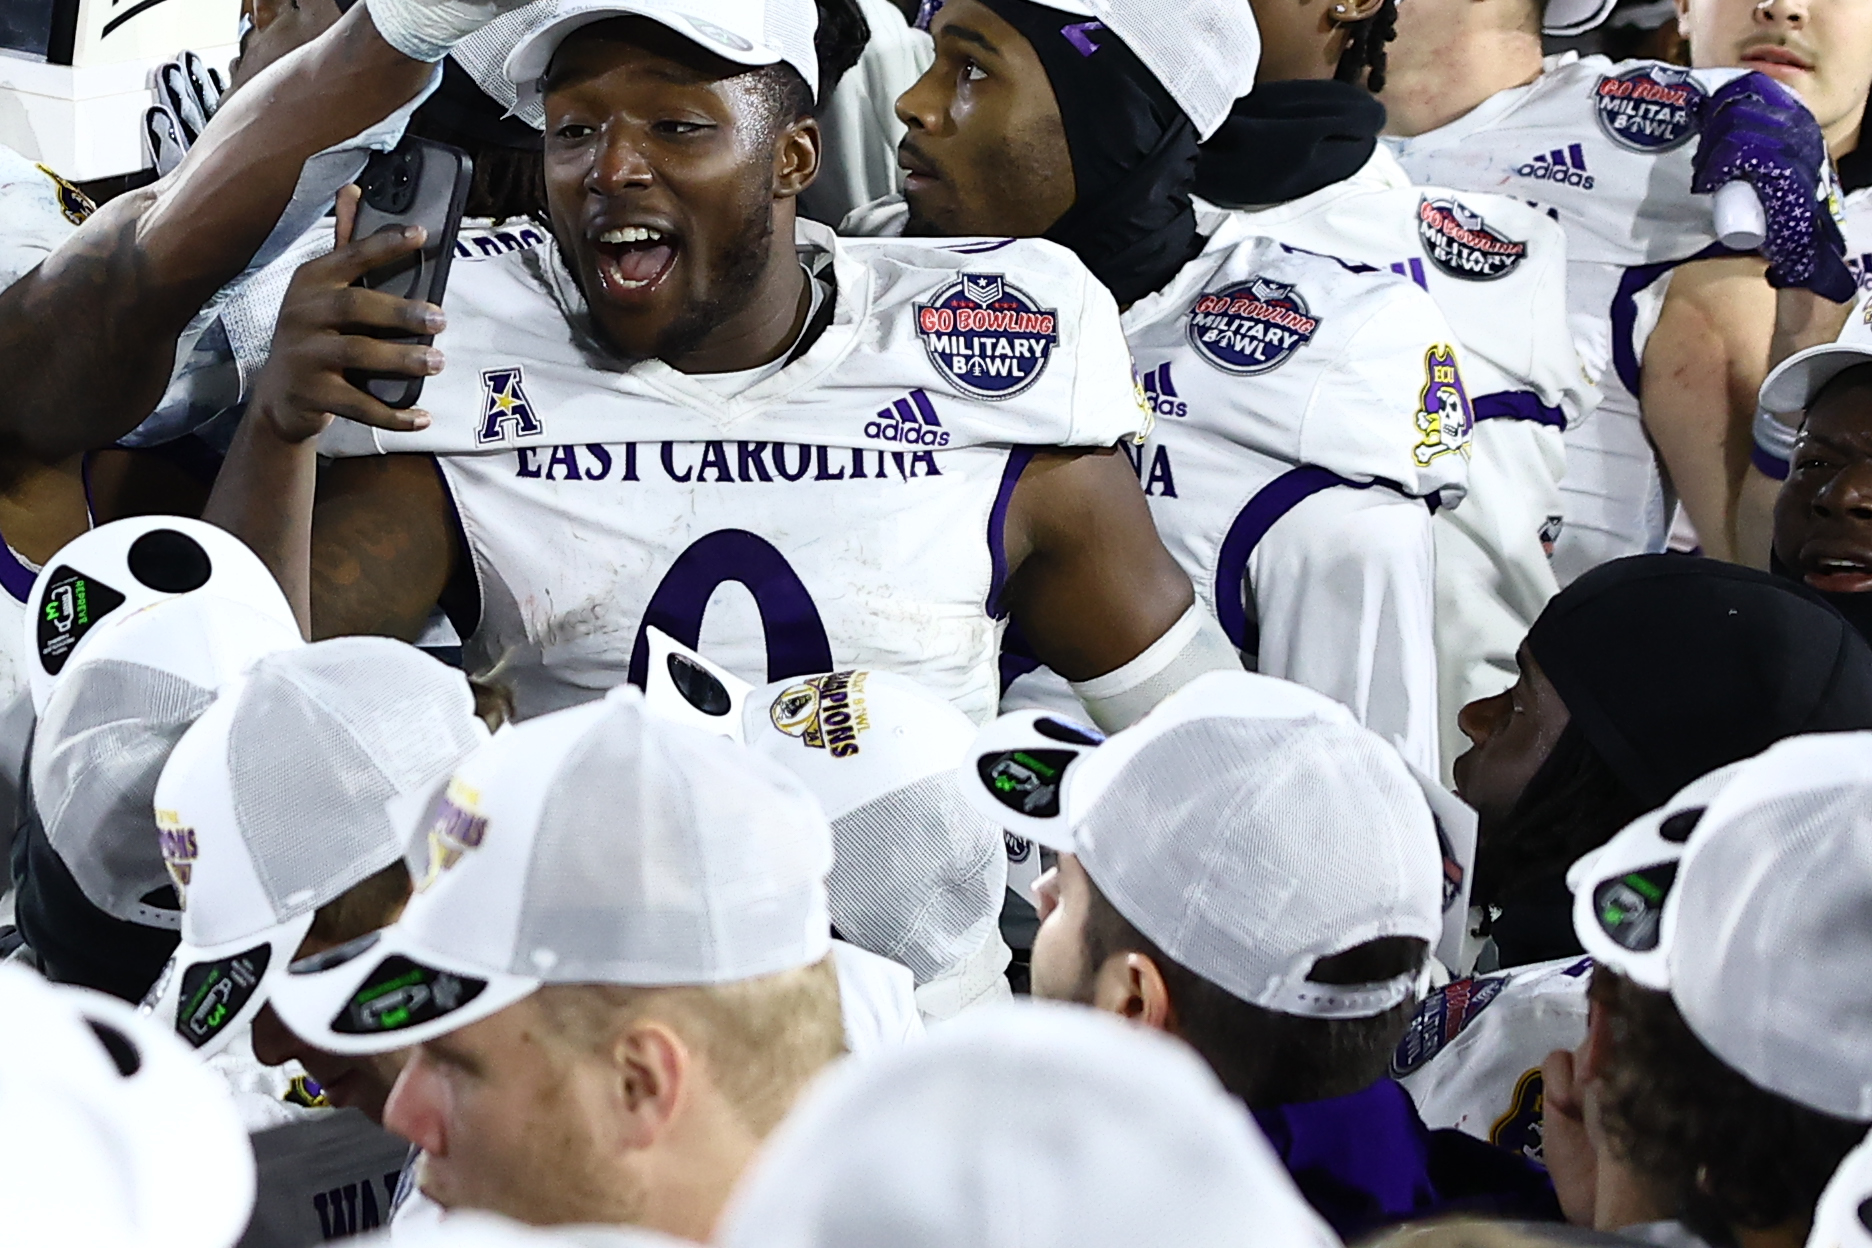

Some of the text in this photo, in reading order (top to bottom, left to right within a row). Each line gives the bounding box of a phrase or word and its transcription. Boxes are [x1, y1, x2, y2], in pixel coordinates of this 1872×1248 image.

[1632, 82, 1688, 106] BOWL
[1599, 97, 1687, 127] MILITAR
[1517, 162, 1595, 190] adidas
[1420, 221, 1517, 266] MILITARY
[920, 307, 1054, 335] GO BOWLING
[1195, 295, 1316, 334] GO BOWLING
[1192, 312, 1300, 349] MILITARY
[928, 334, 1047, 358] MILITARY
[1201, 328, 1267, 362] BOWL
[952, 356, 1025, 377] BOWL
[1434, 365, 1455, 383] ECU
[864, 418, 950, 446] adidas
